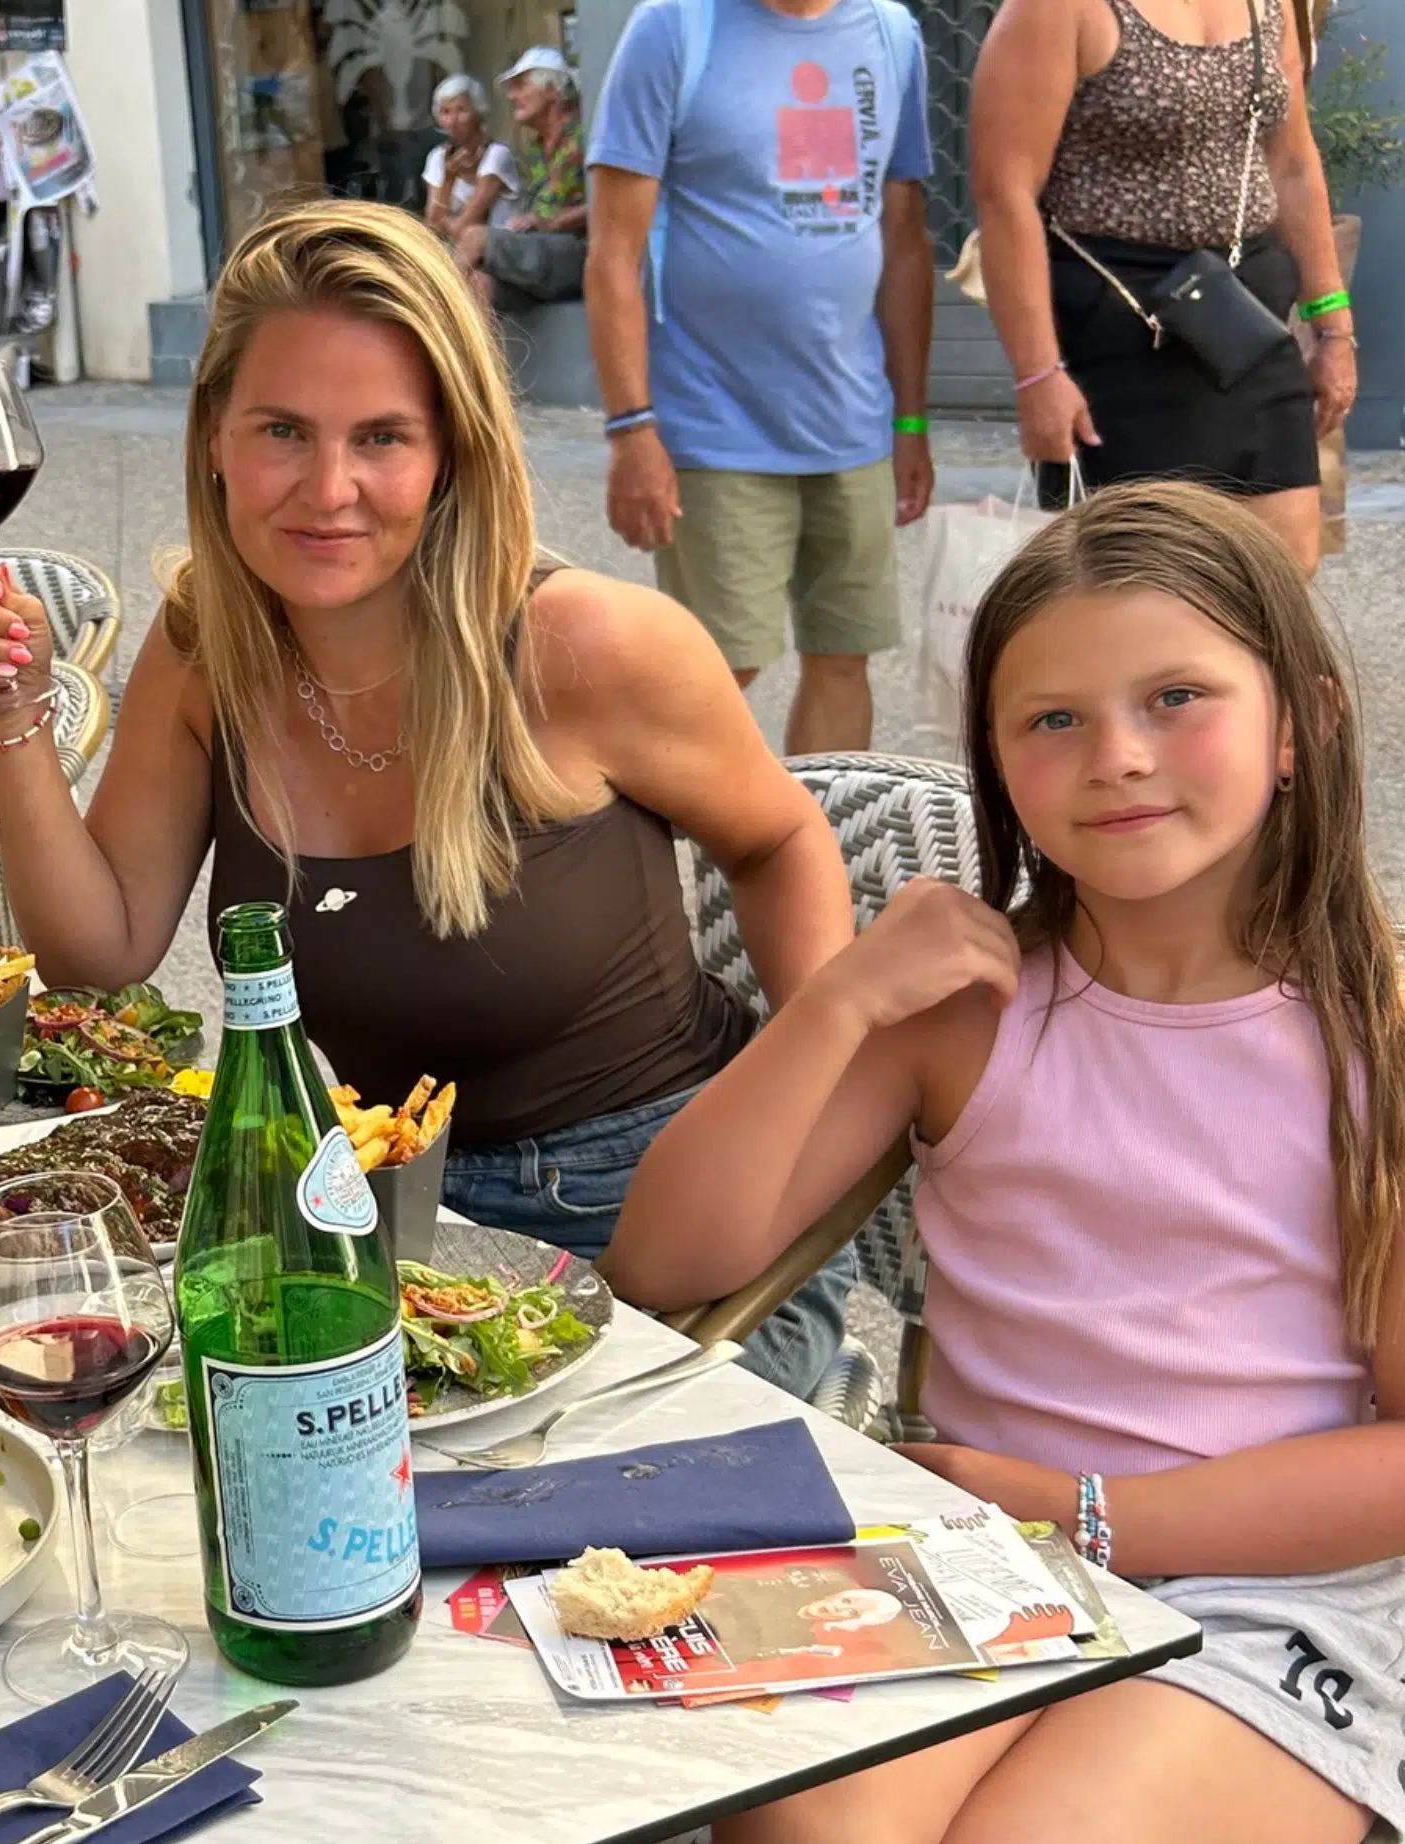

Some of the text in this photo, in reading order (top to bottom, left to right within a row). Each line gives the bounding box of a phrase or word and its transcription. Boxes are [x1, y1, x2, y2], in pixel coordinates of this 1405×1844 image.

[296, 1374, 405, 1437] S.PELLE
[879, 1556, 908, 1594] EVA
[902, 1599, 944, 1651] JEAN
[650, 1635, 690, 1673] ÈRE
